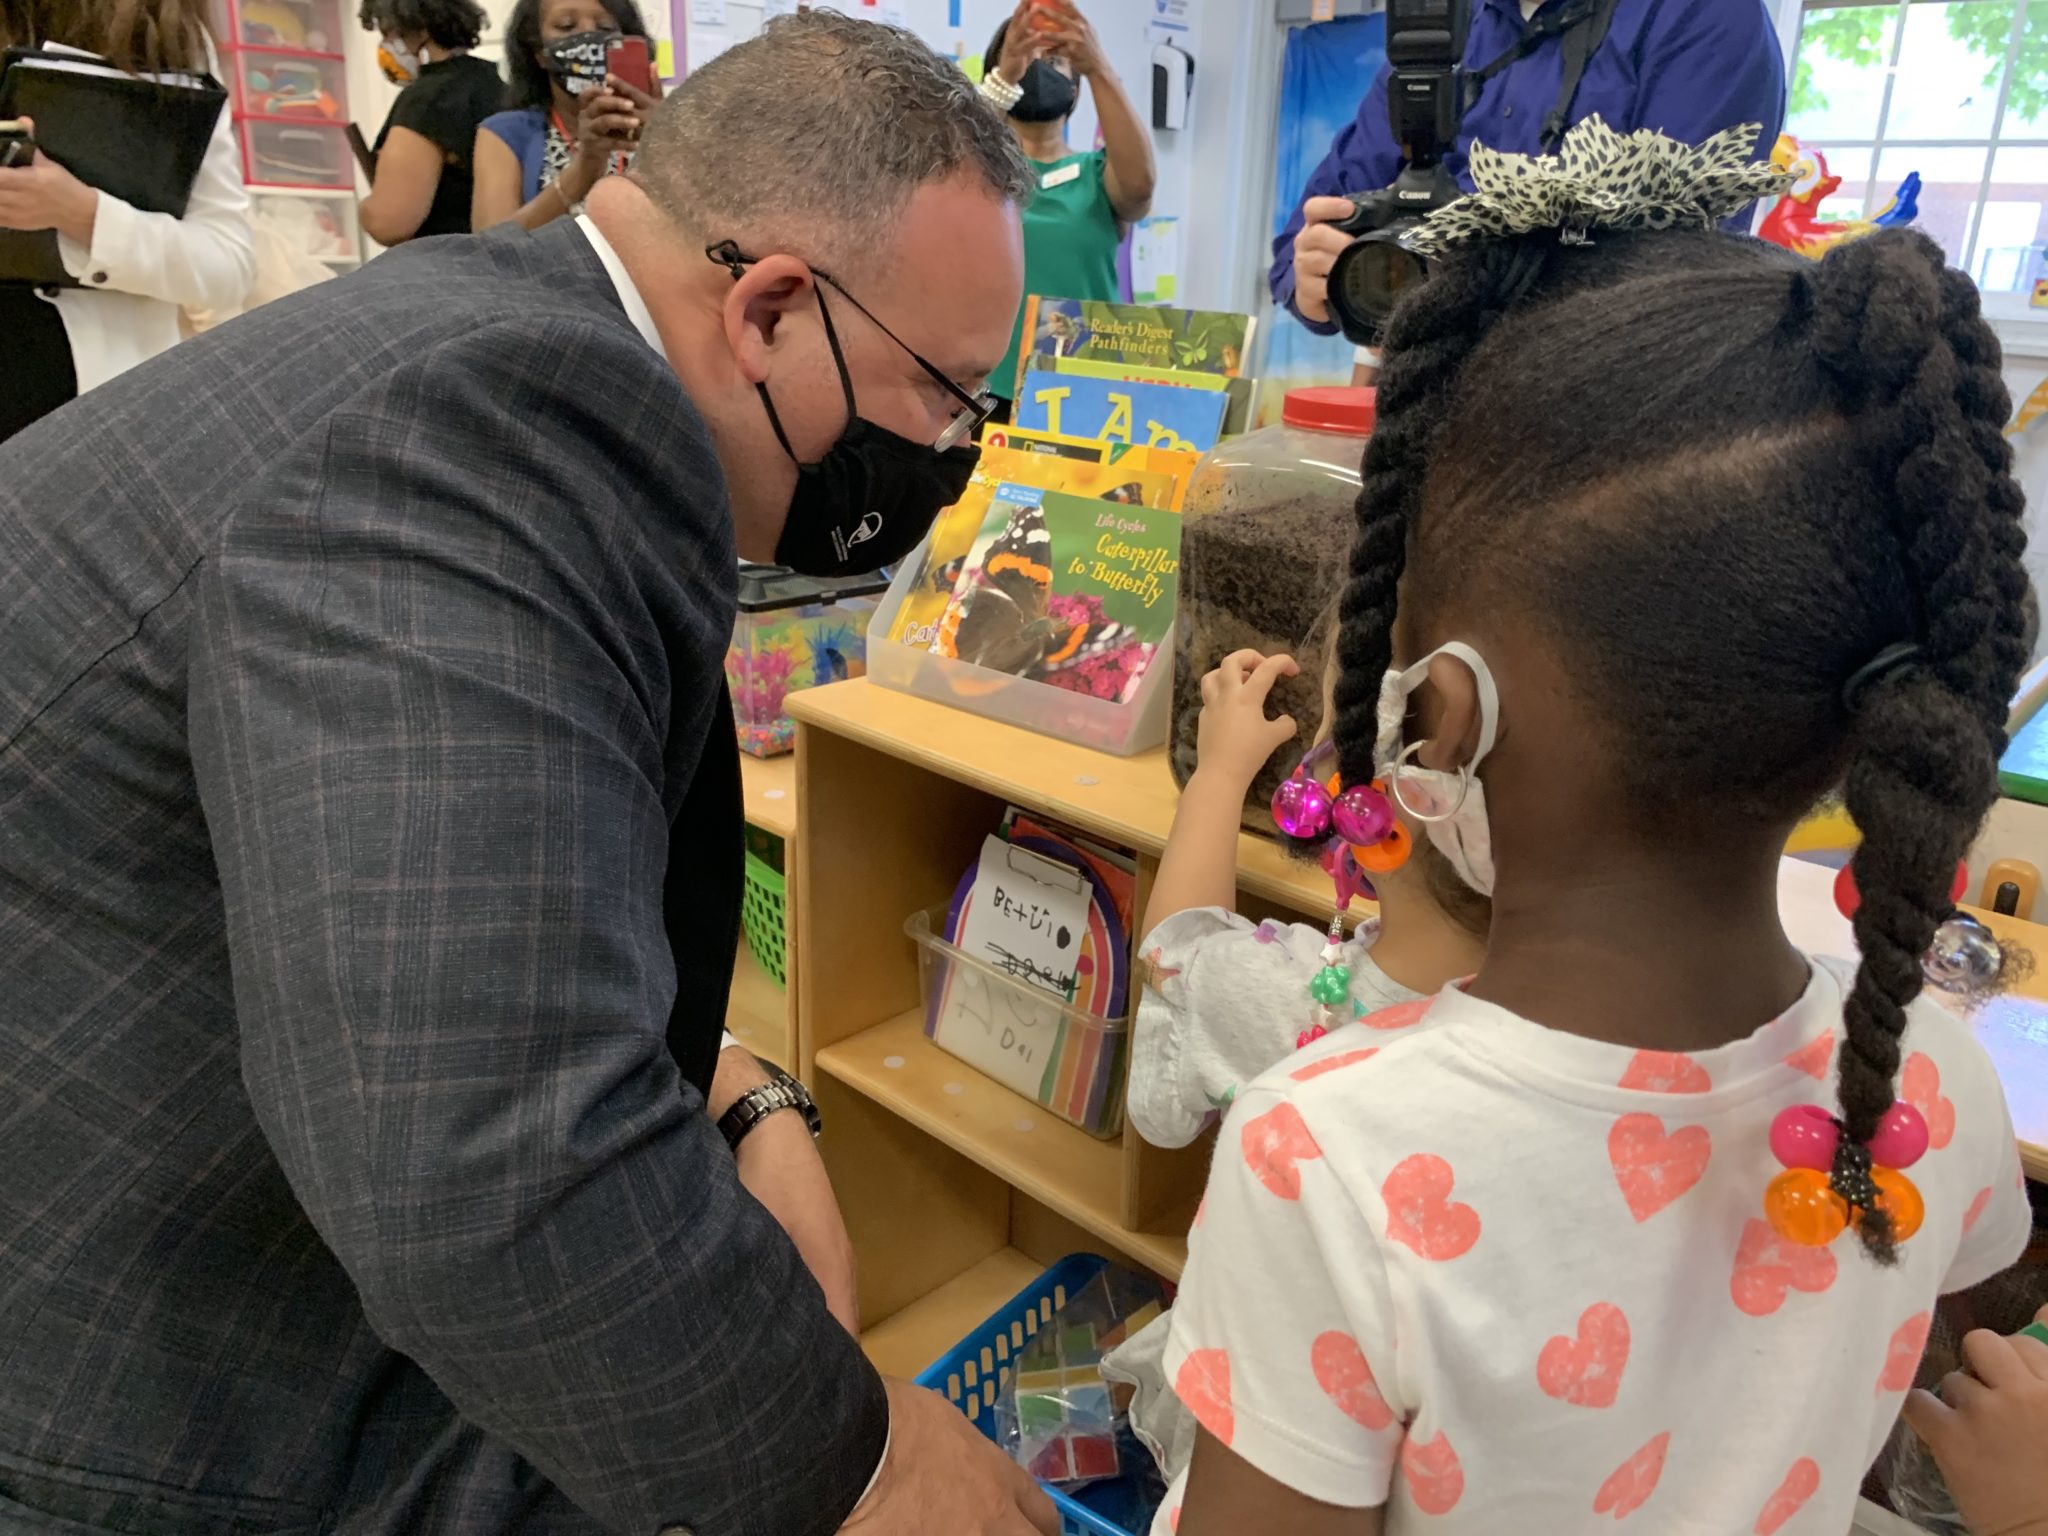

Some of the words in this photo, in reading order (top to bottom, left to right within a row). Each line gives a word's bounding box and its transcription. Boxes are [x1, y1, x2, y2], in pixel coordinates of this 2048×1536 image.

[1399, 190, 1431, 200] Canon
[1091, 318, 1134, 335] Reader's
[1136, 322, 1173, 342] Digest
[1090, 334, 1169, 354] Pathfinders
[1095, 513, 1115, 528] Life
[1116, 518, 1147, 535] Cycles
[1096, 533, 1178, 574] Caterpillar
[1067, 556, 1086, 575] to
[1090, 561, 1164, 609] Butterfly
